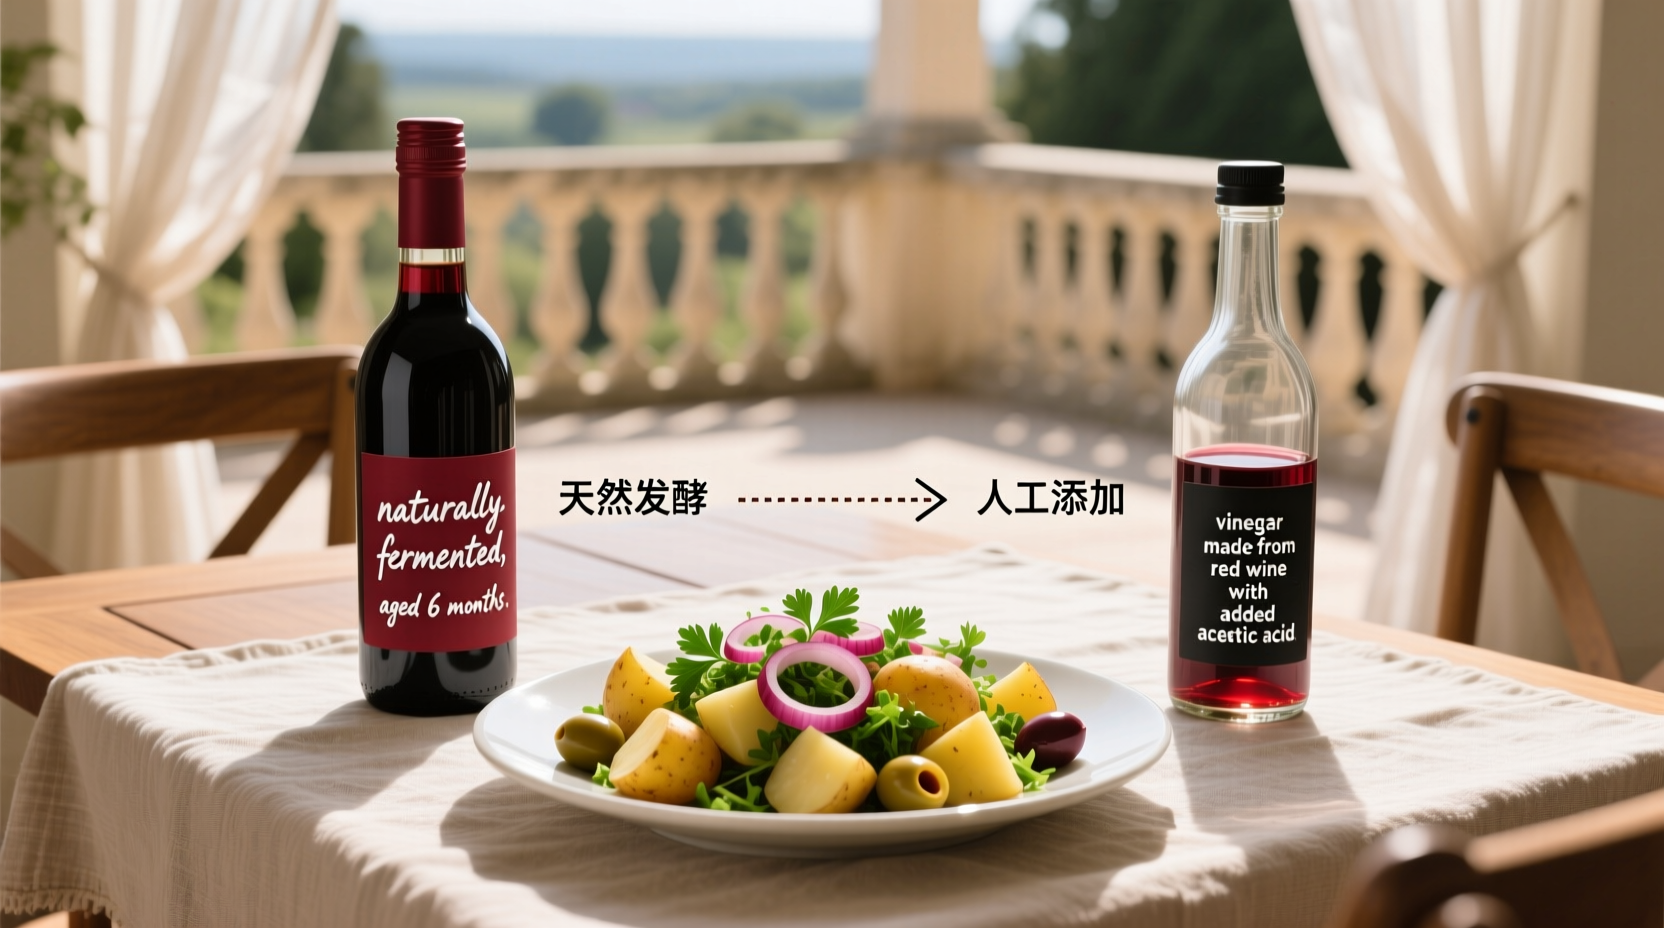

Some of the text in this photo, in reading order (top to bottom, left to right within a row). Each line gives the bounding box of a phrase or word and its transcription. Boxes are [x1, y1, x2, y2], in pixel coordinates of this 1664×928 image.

[1216, 512, 1284, 536] vinegar
[376, 529, 506, 581] fermented,
[1203, 537, 1296, 555] made from
[1210, 559, 1288, 578] red wine
[1228, 582, 1269, 600] with
[379, 582, 509, 628] aged 6 months.
[1219, 604, 1276, 623] added
